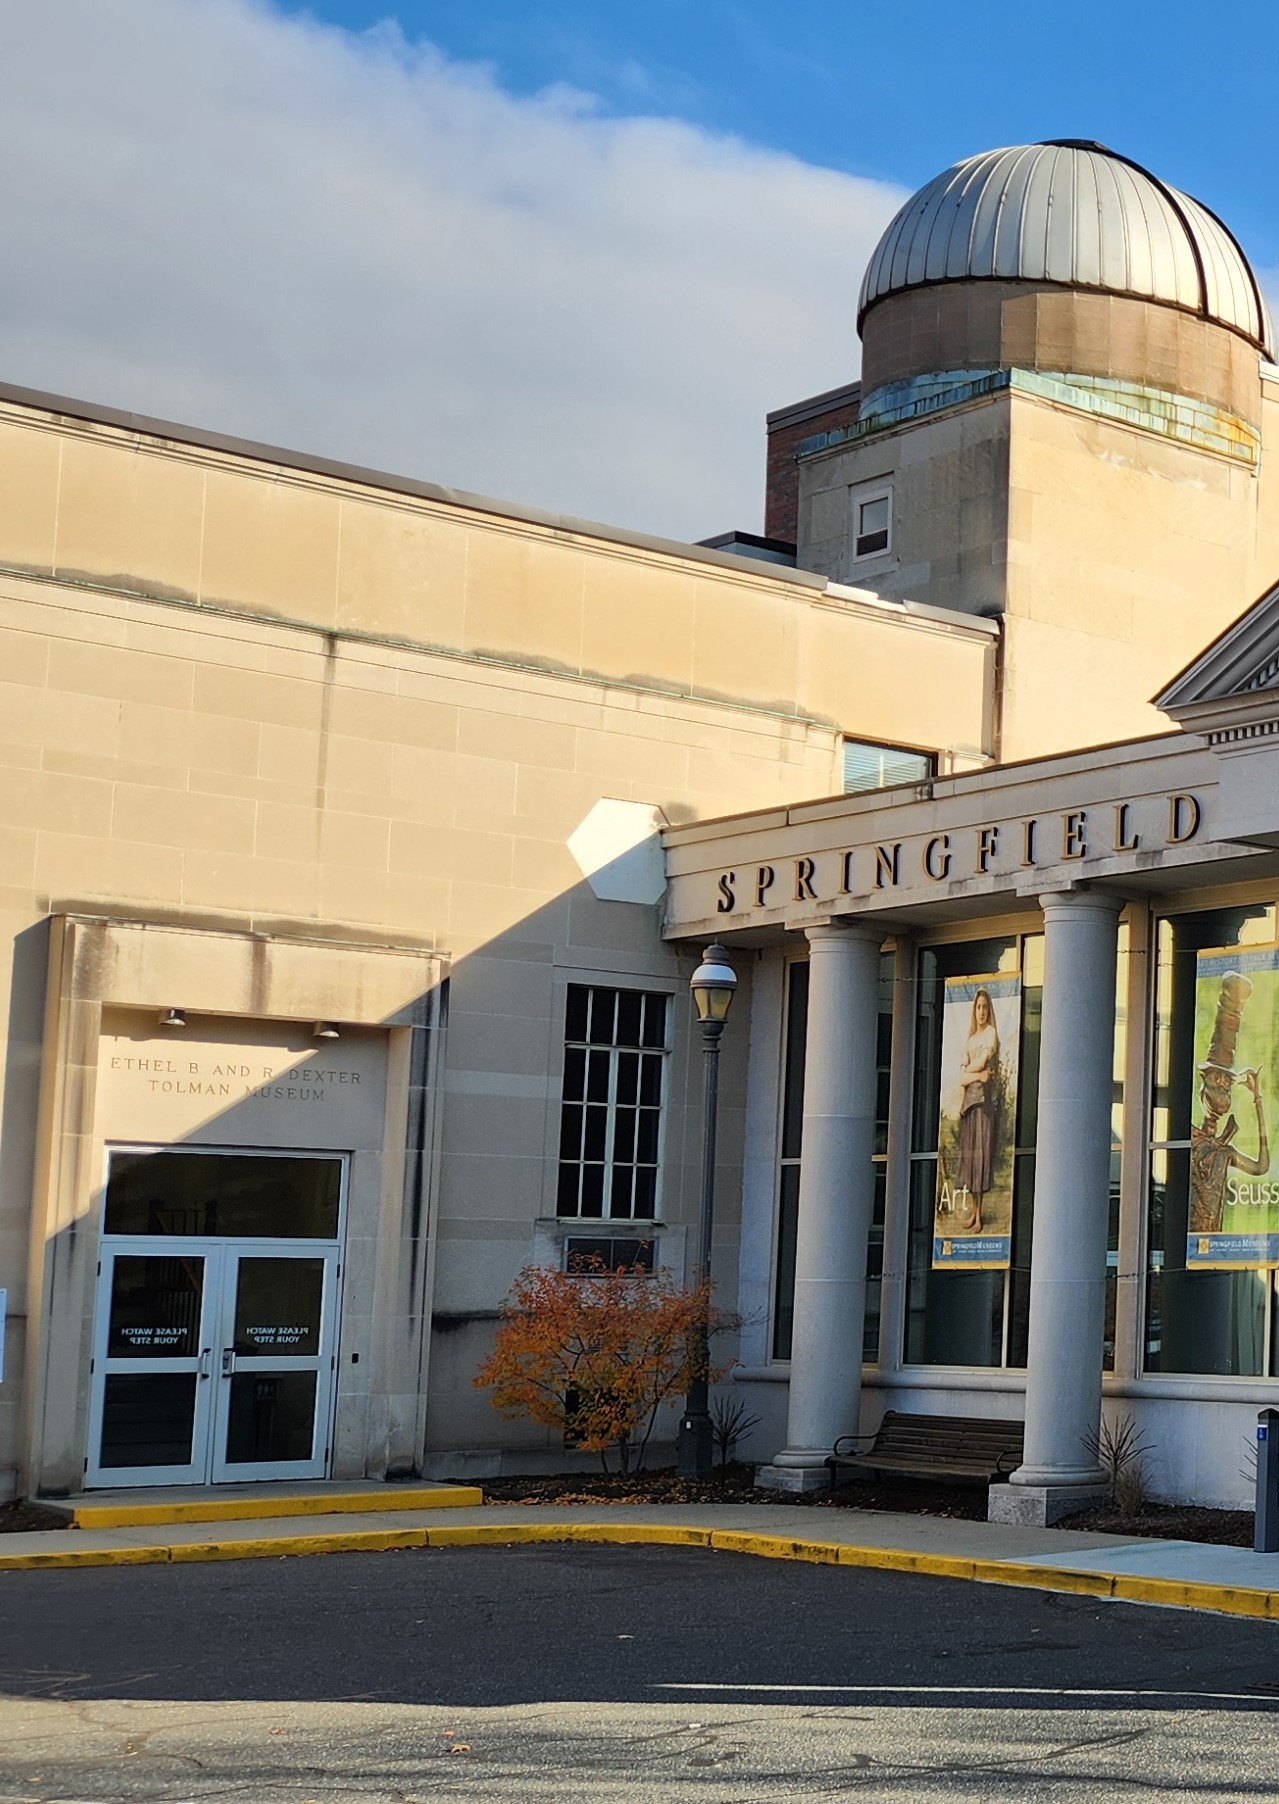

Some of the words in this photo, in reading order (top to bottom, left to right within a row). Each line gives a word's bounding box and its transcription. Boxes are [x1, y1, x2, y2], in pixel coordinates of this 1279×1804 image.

[717, 794, 1201, 913] SPRINGFIELD
[111, 1058, 177, 1073] ETHEL
[213, 1064, 250, 1077] AND
[289, 1069, 361, 1084] DEXTER
[150, 1080, 230, 1095] TOLMAN
[245, 1086, 325, 1101] MUSEUM
[938, 1182, 969, 1211] Art
[1226, 1177, 1279, 1205] Seuss
